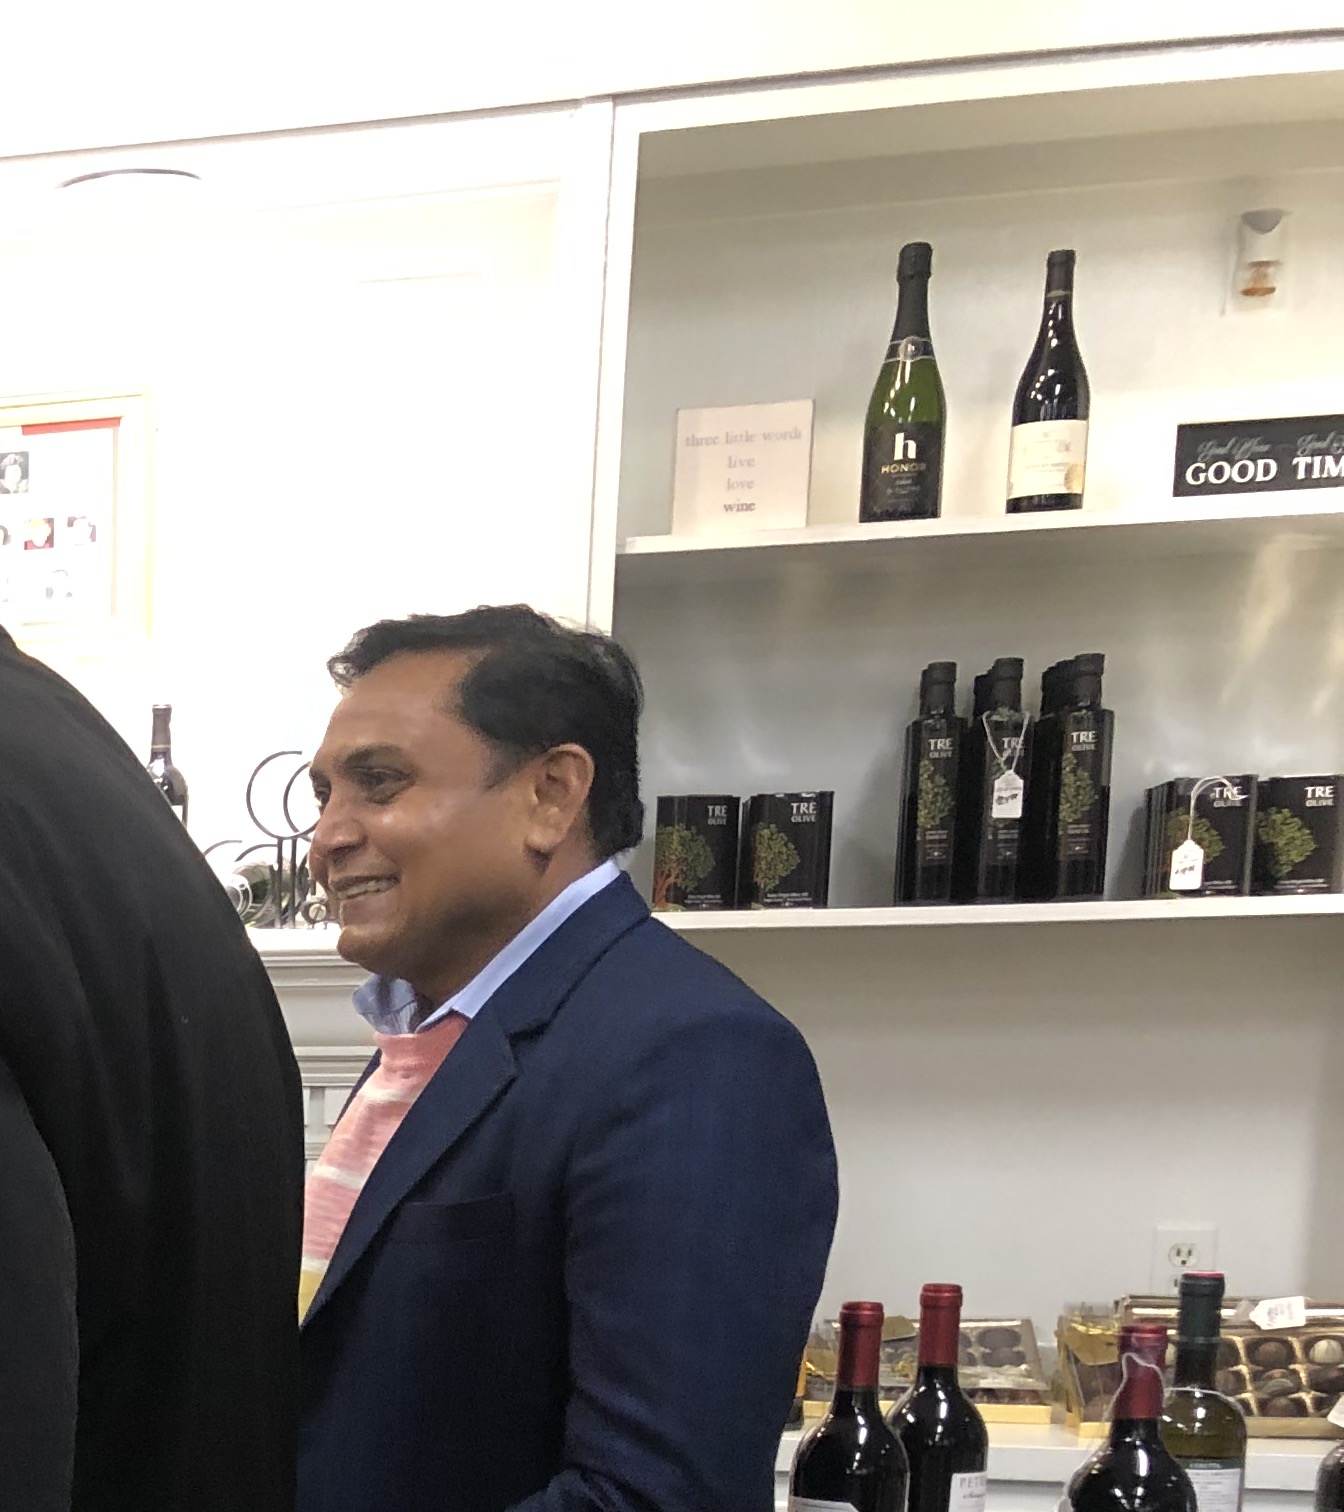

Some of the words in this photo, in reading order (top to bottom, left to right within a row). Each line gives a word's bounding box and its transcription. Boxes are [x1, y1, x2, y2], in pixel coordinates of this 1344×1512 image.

[685, 433, 720, 447] three
[725, 431, 757, 445] little
[762, 426, 803, 442] words
[894, 432, 917, 460] h
[1184, 457, 1278, 486] GOOD
[727, 478, 755, 491] love
[723, 499, 756, 513] wine
[928, 737, 954, 750] TRE
[1071, 730, 1097, 743] TRE
[1304, 785, 1335, 799] TRE
[707, 804, 728, 817] TRE
[790, 801, 817, 815] TRE
